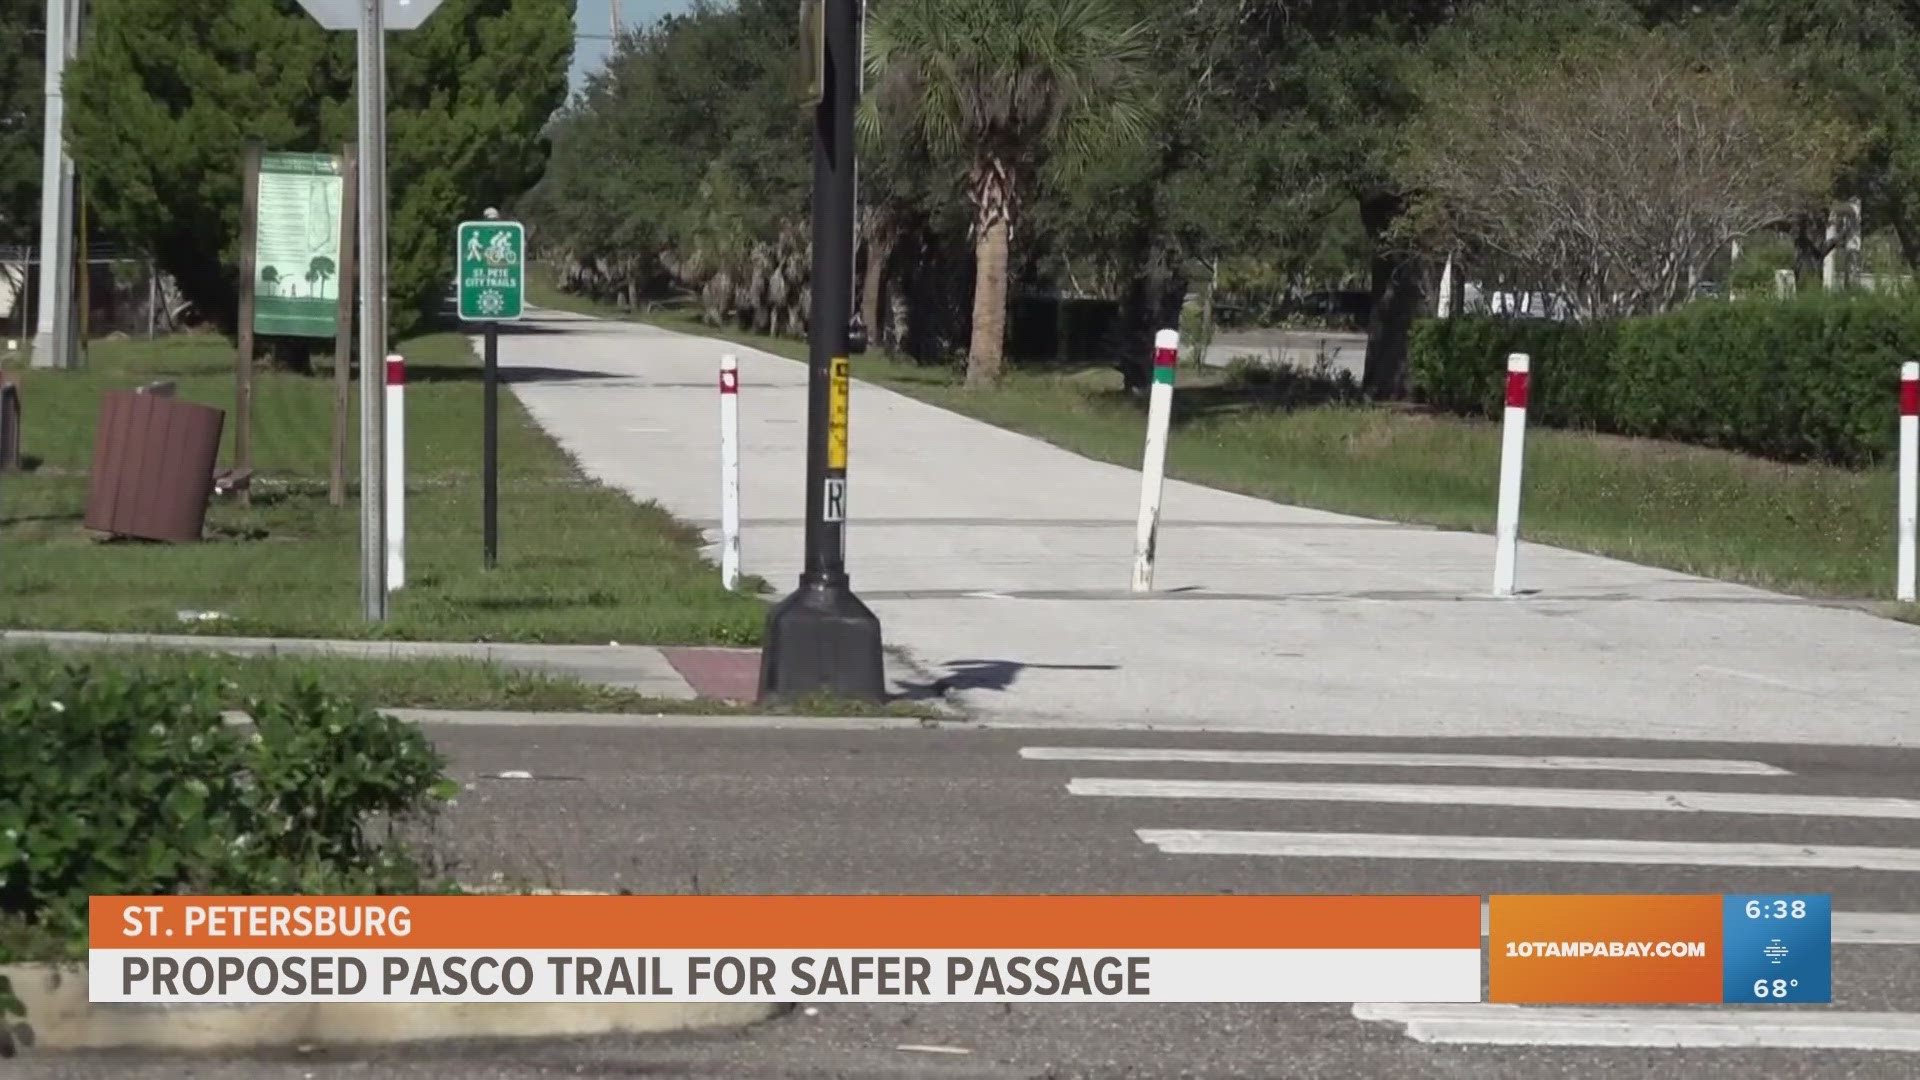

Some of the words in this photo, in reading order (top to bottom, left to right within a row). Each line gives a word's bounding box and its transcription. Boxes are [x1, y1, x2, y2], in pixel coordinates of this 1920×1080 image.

[487, 268, 508, 278] PETE
[465, 278, 484, 287] CITY
[486, 278, 516, 287] TRAILS
[828, 480, 843, 519] R
